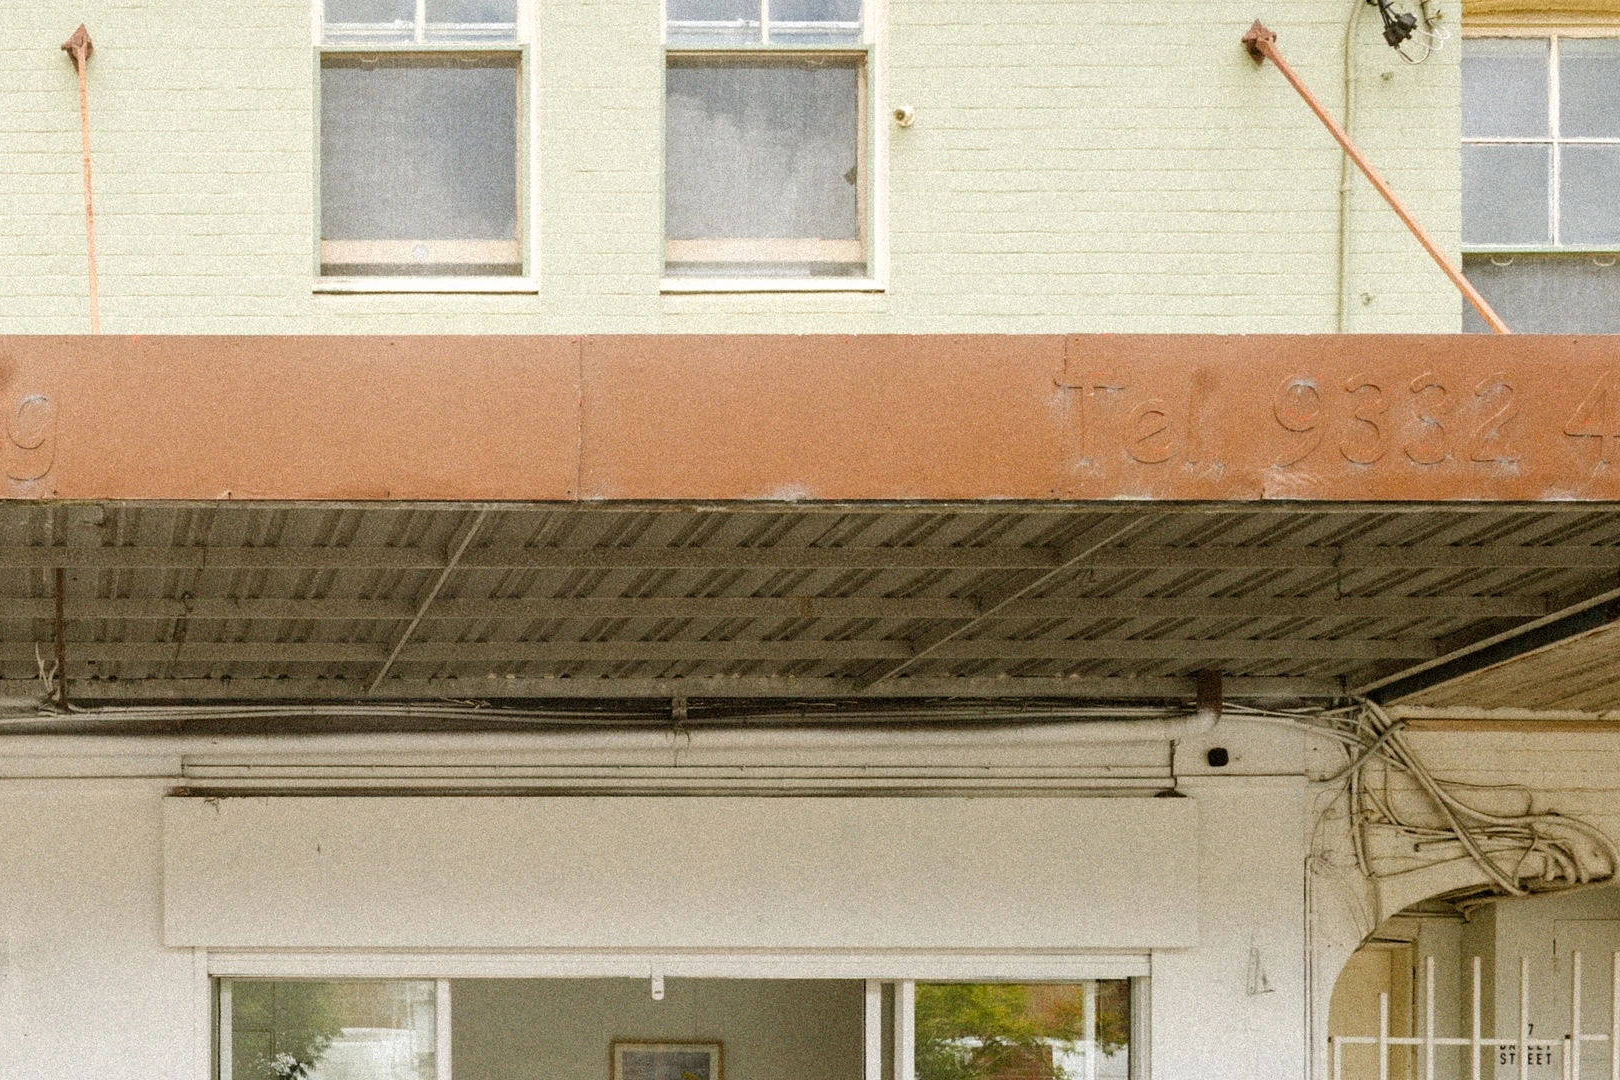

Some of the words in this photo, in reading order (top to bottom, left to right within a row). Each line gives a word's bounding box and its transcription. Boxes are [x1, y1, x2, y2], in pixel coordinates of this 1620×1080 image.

[1273, 370, 1520, 469] 9332
[1528, 1024, 1534, 1035] 7
[1500, 1053, 1551, 1065] STEET
